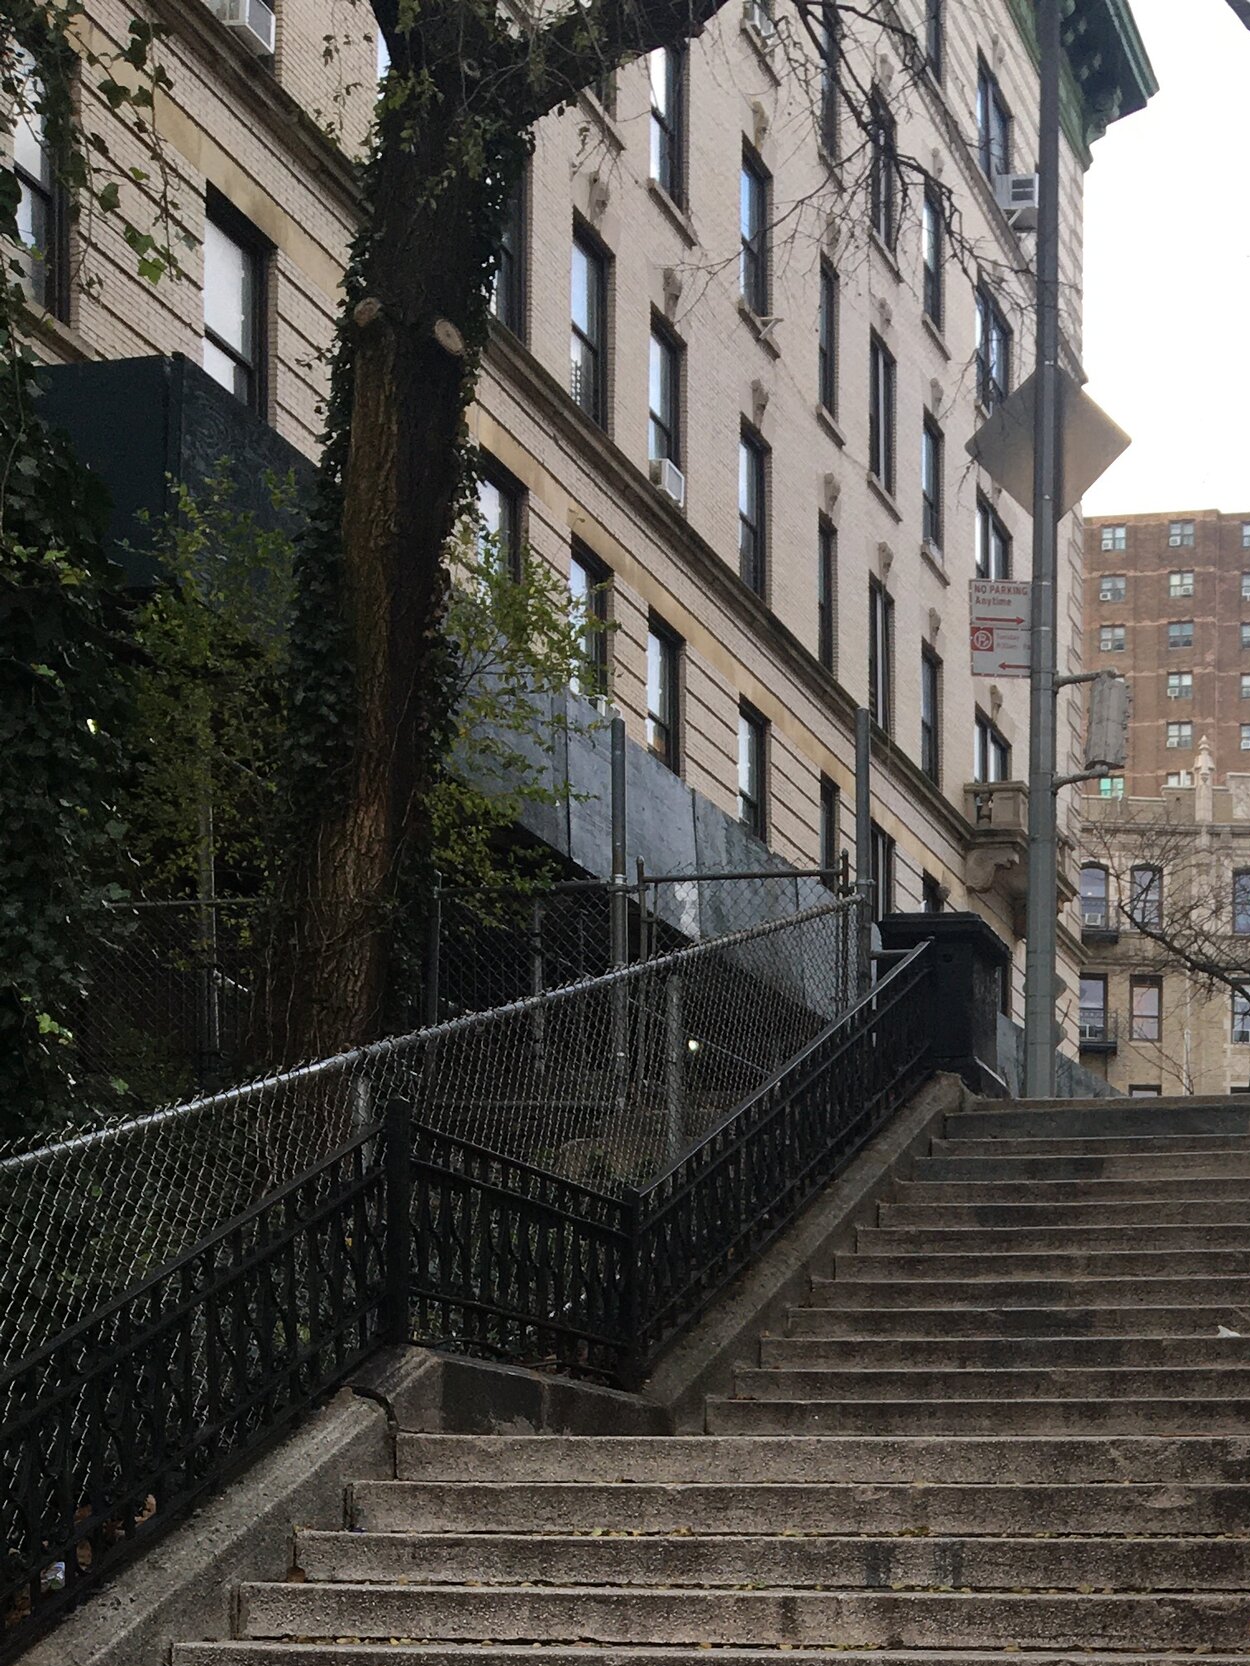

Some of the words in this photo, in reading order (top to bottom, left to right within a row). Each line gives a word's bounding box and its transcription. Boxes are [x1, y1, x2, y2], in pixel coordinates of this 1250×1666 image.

[974, 584, 987, 594] NO
[990, 585, 1028, 596] PARKING
[975, 596, 1012, 607] Anytime
